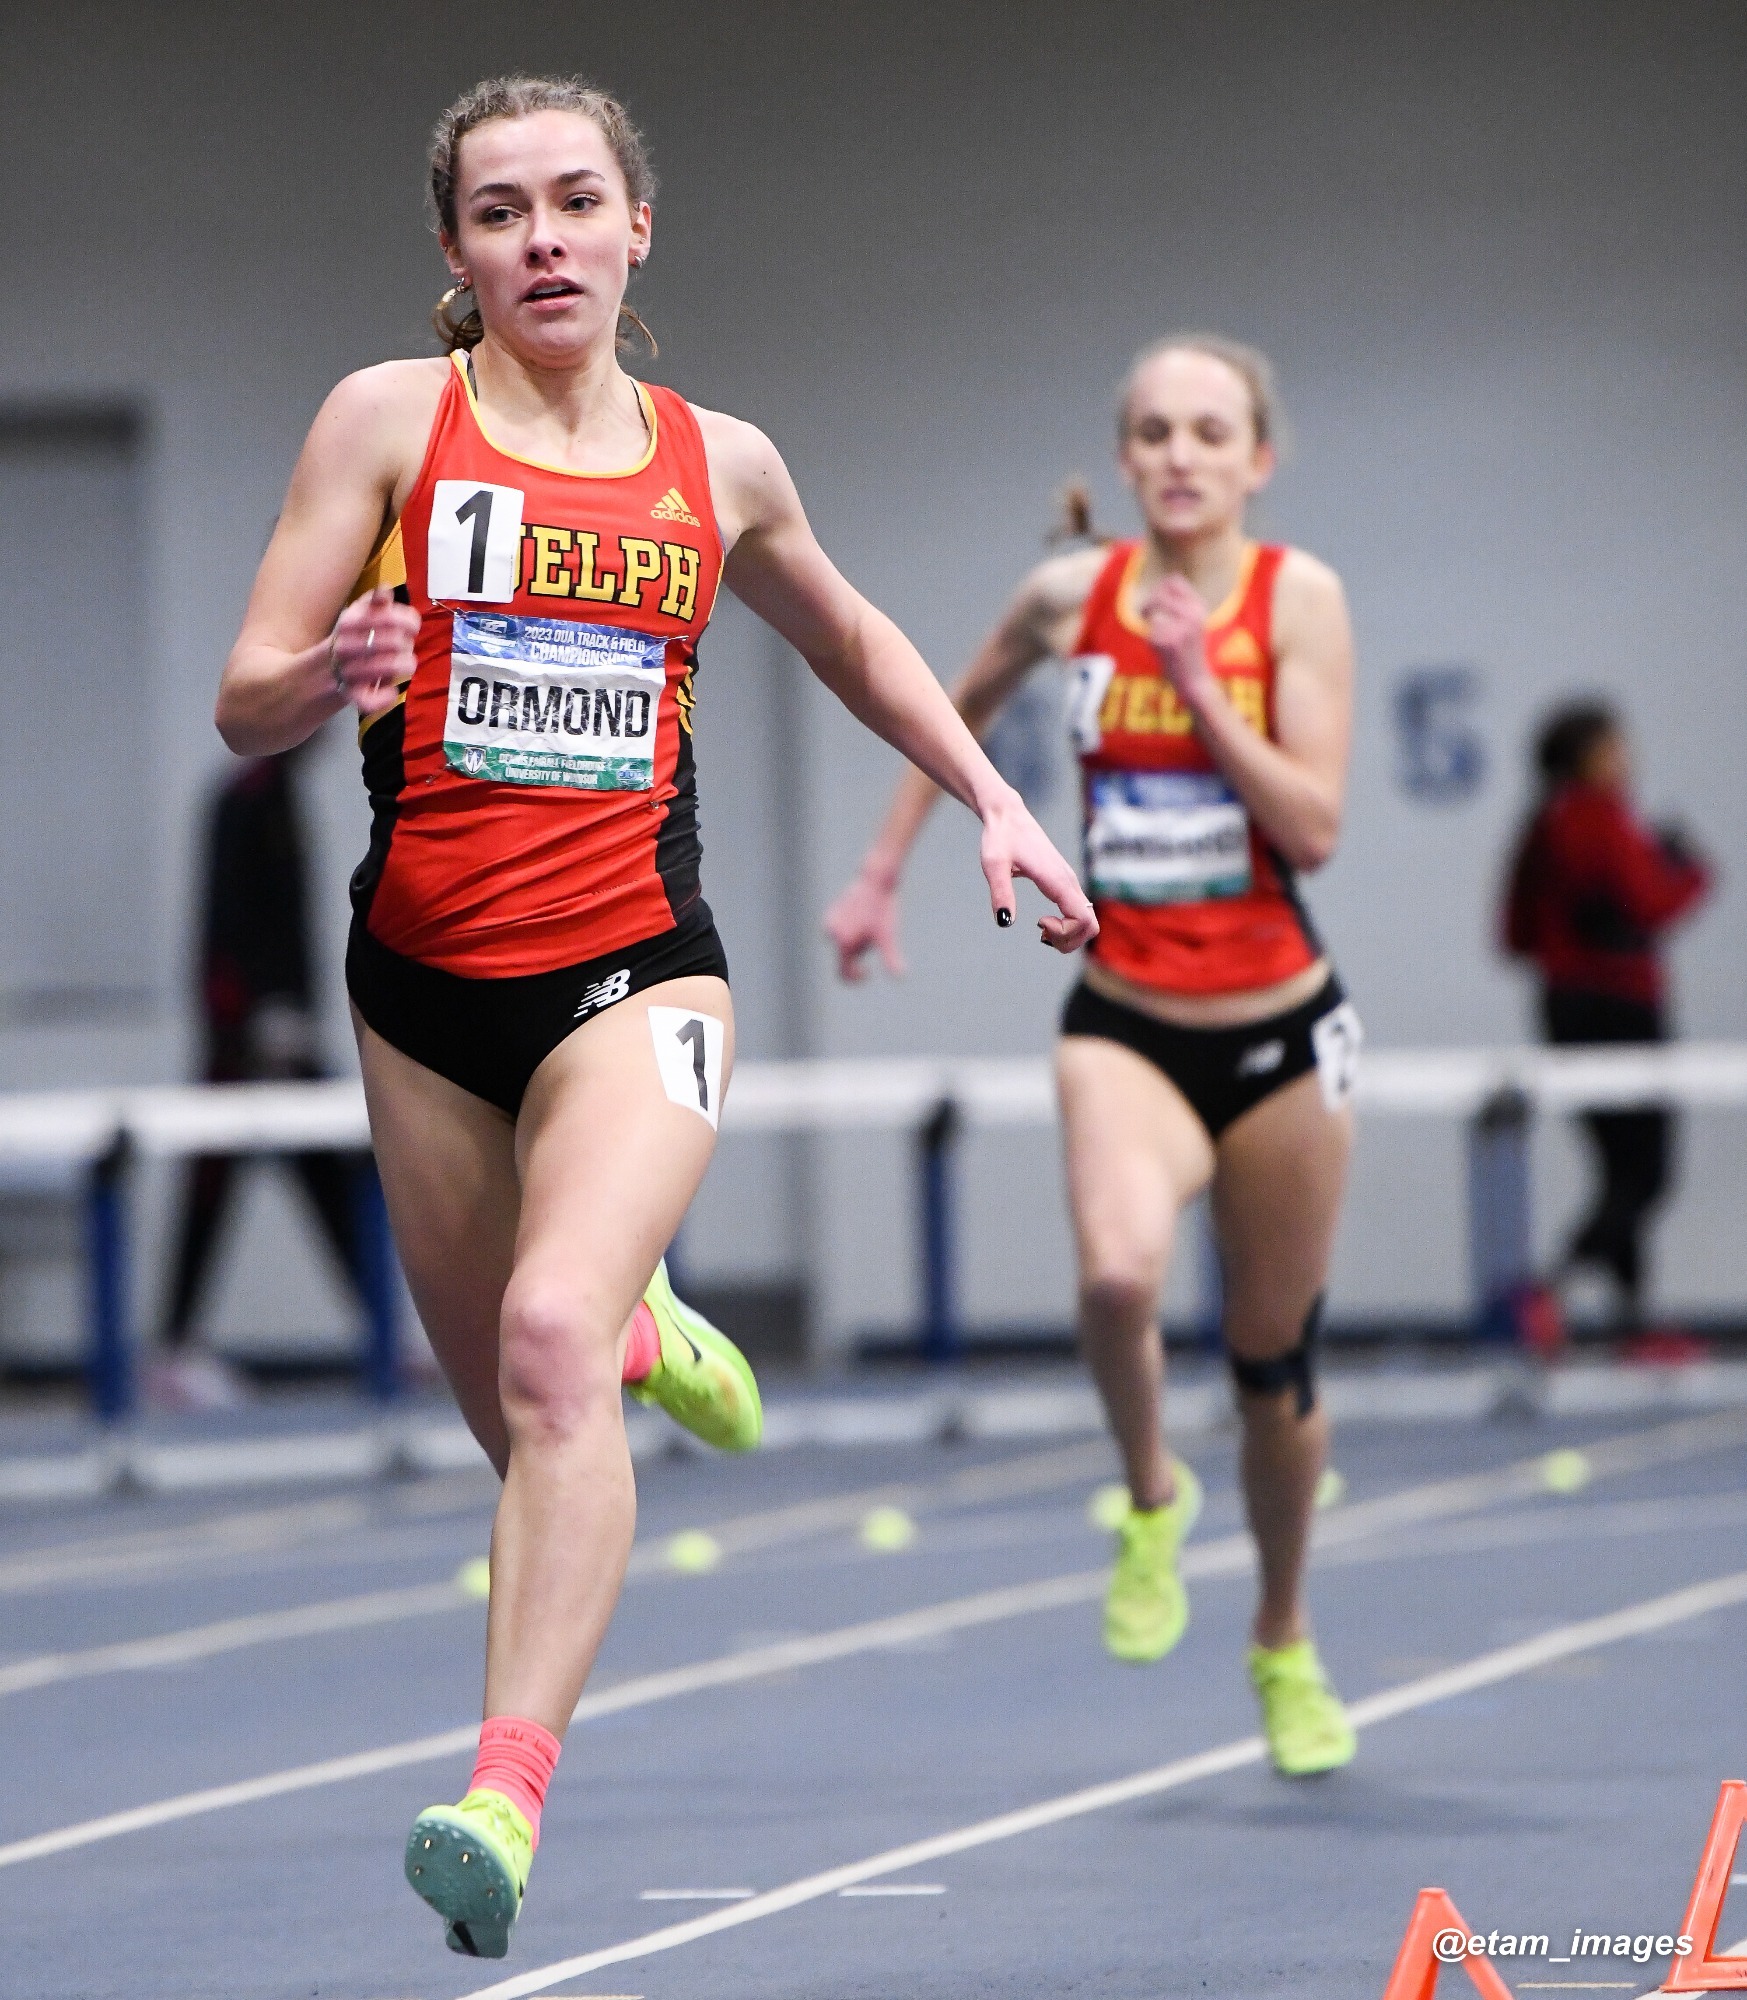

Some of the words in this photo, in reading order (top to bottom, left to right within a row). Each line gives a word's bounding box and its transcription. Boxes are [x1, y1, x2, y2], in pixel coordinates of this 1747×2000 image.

[650, 508, 701, 528] adidas
[455, 489, 494, 594] 1
[524, 626, 553, 641] 2023
[577, 632, 610, 649] TRACK
[620, 638, 646, 653] FIELD
[457, 676, 651, 738] ORMOND
[505, 766, 551, 781] UNIVERSITY
[551, 770, 562, 781] OF
[675, 1018, 708, 1112] 1
